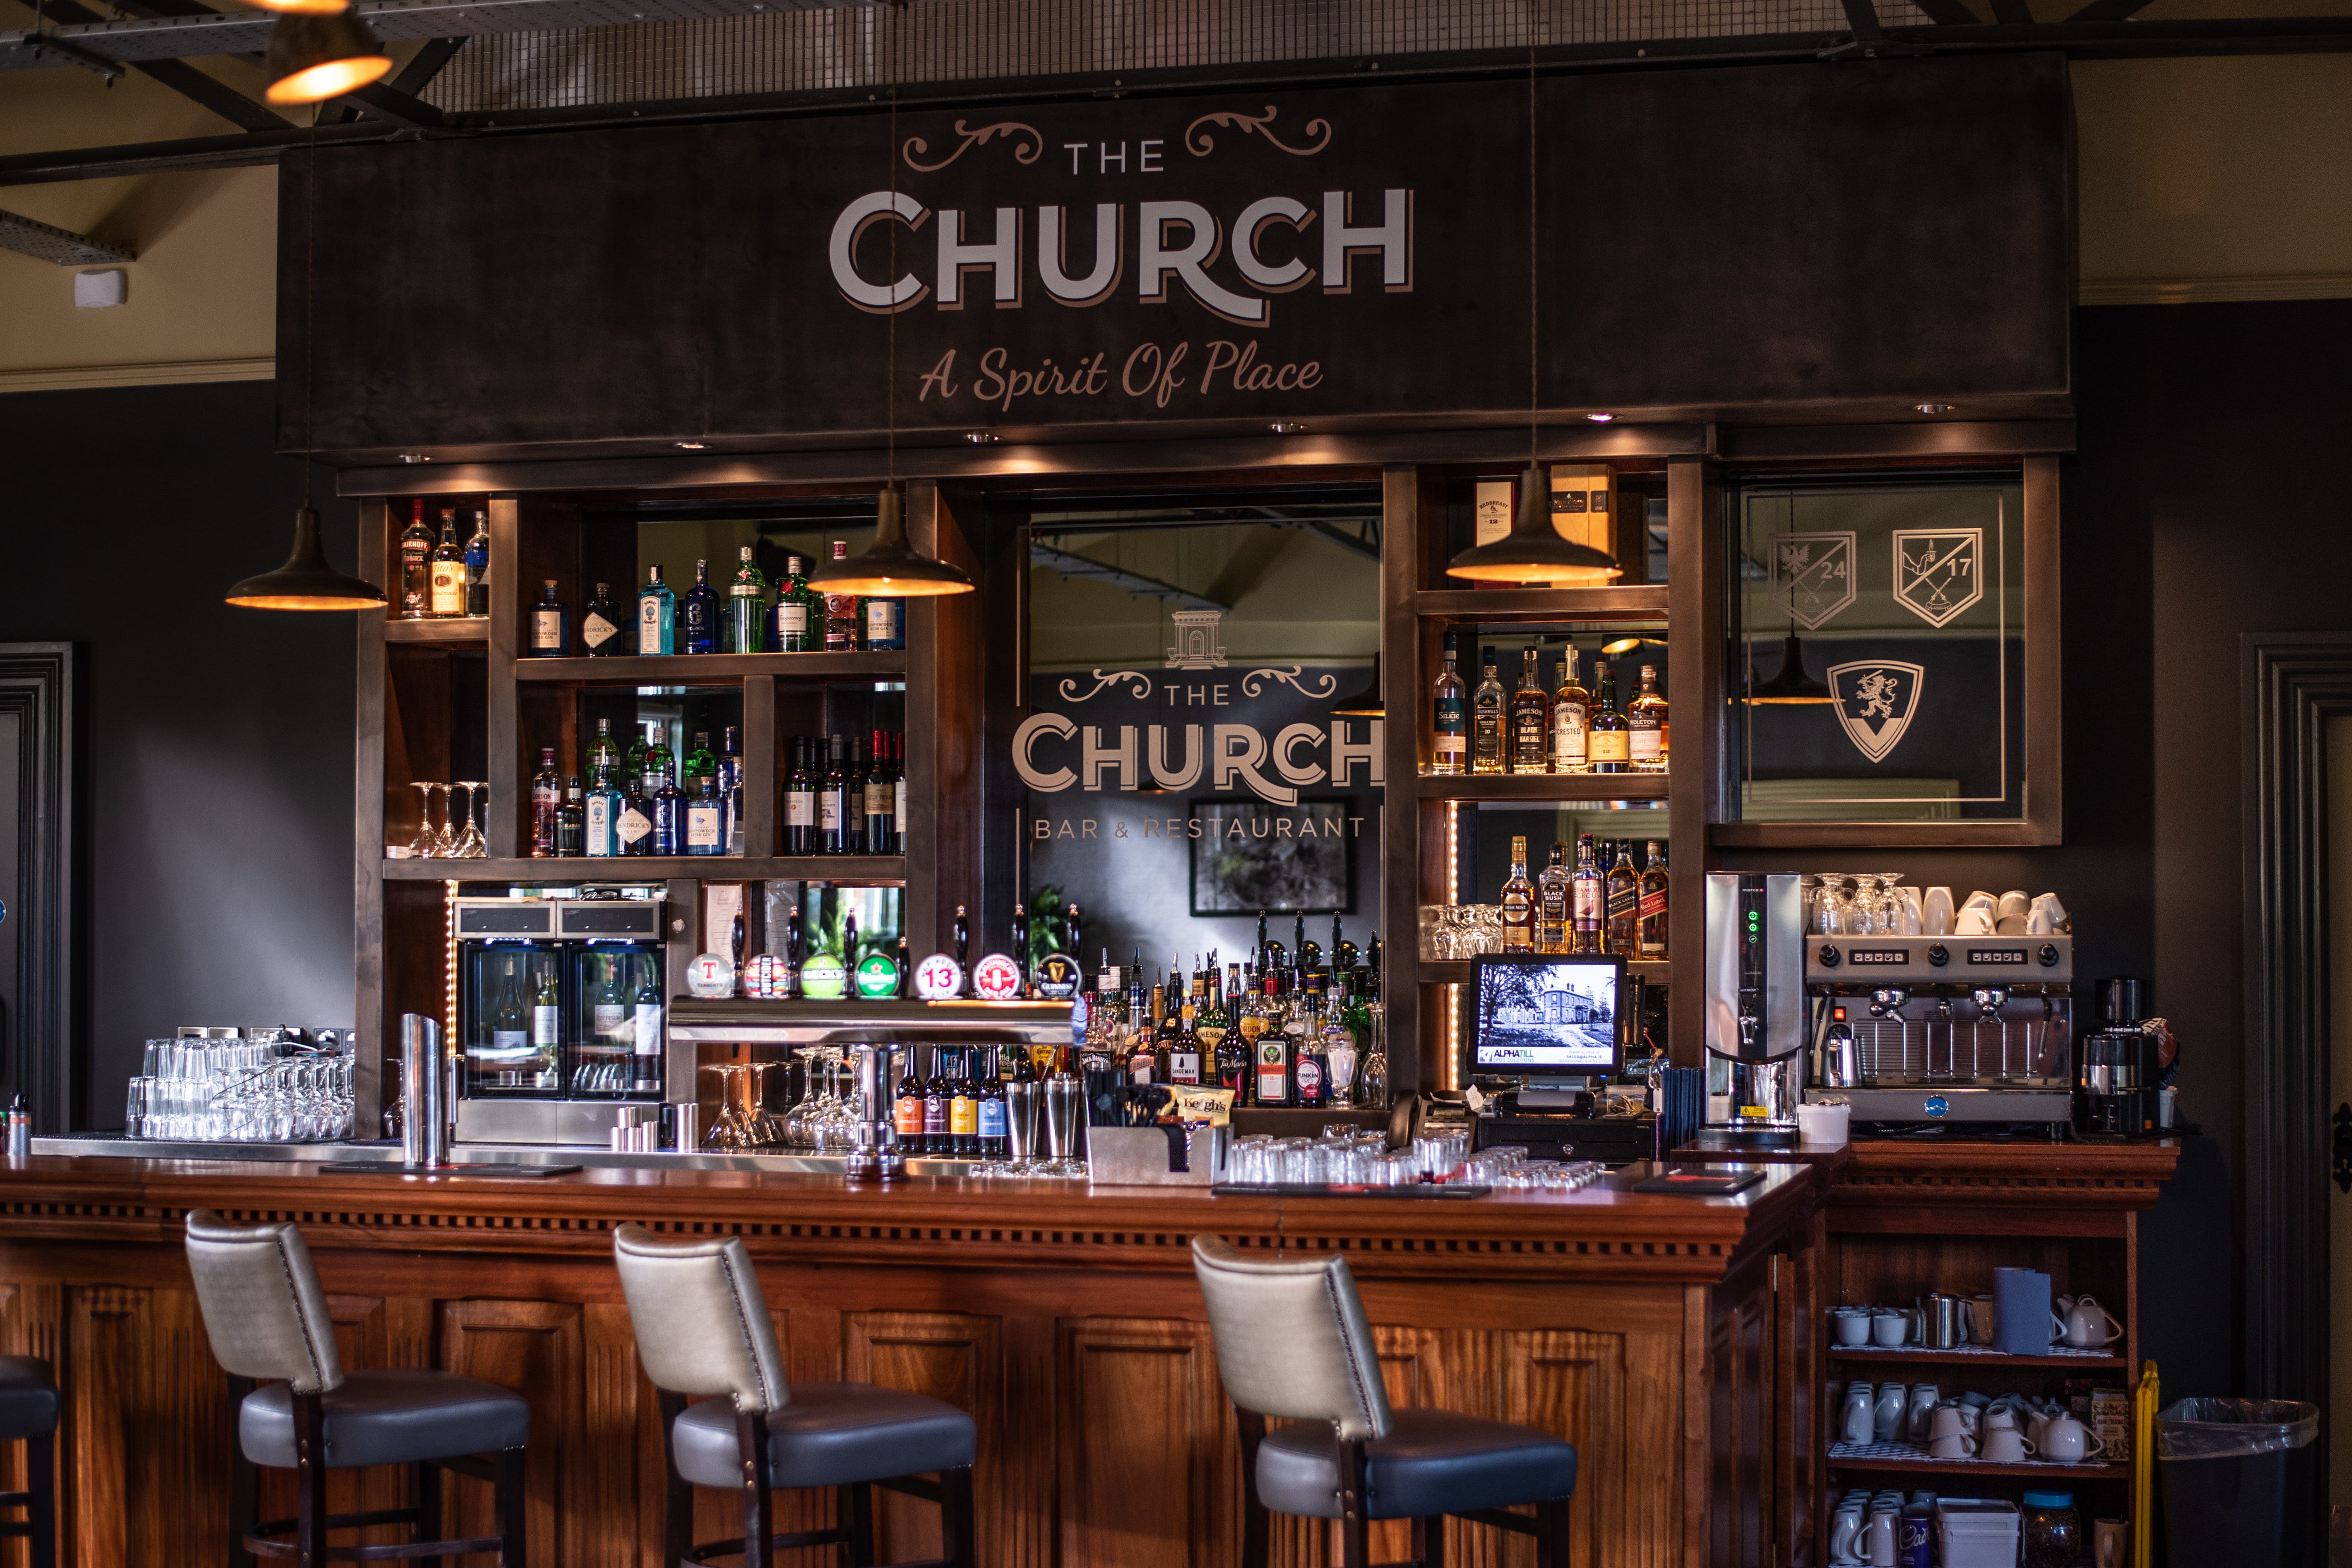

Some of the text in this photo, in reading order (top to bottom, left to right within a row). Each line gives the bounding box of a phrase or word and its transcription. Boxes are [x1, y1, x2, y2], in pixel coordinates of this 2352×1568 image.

[1065, 140, 1164, 174] THE
[829, 189, 1413, 328] CHURCH
[920, 341, 1324, 412] A Spirit Of Place
[1479, 500, 1509, 509] REDBREAST
[1820, 561, 1846, 579] 24
[1947, 558, 1971, 577] 17
[1164, 685, 1230, 705] THE
[1516, 708, 1543, 717] JAMESON
[1556, 707, 1582, 715] JAMESON
[1012, 712, 1385, 807] CHURCH
[1035, 818, 1365, 839] BAR & RESTAURANT
[1651, 897, 1665, 906] Label
[702, 961, 718, 982] T
[926, 968, 953, 988] 13
[1199, 1031, 1224, 1039] AMESON
[1219, 1058, 1247, 1068] Tia Maria
[1183, 1098, 1226, 1113] Kegh's
